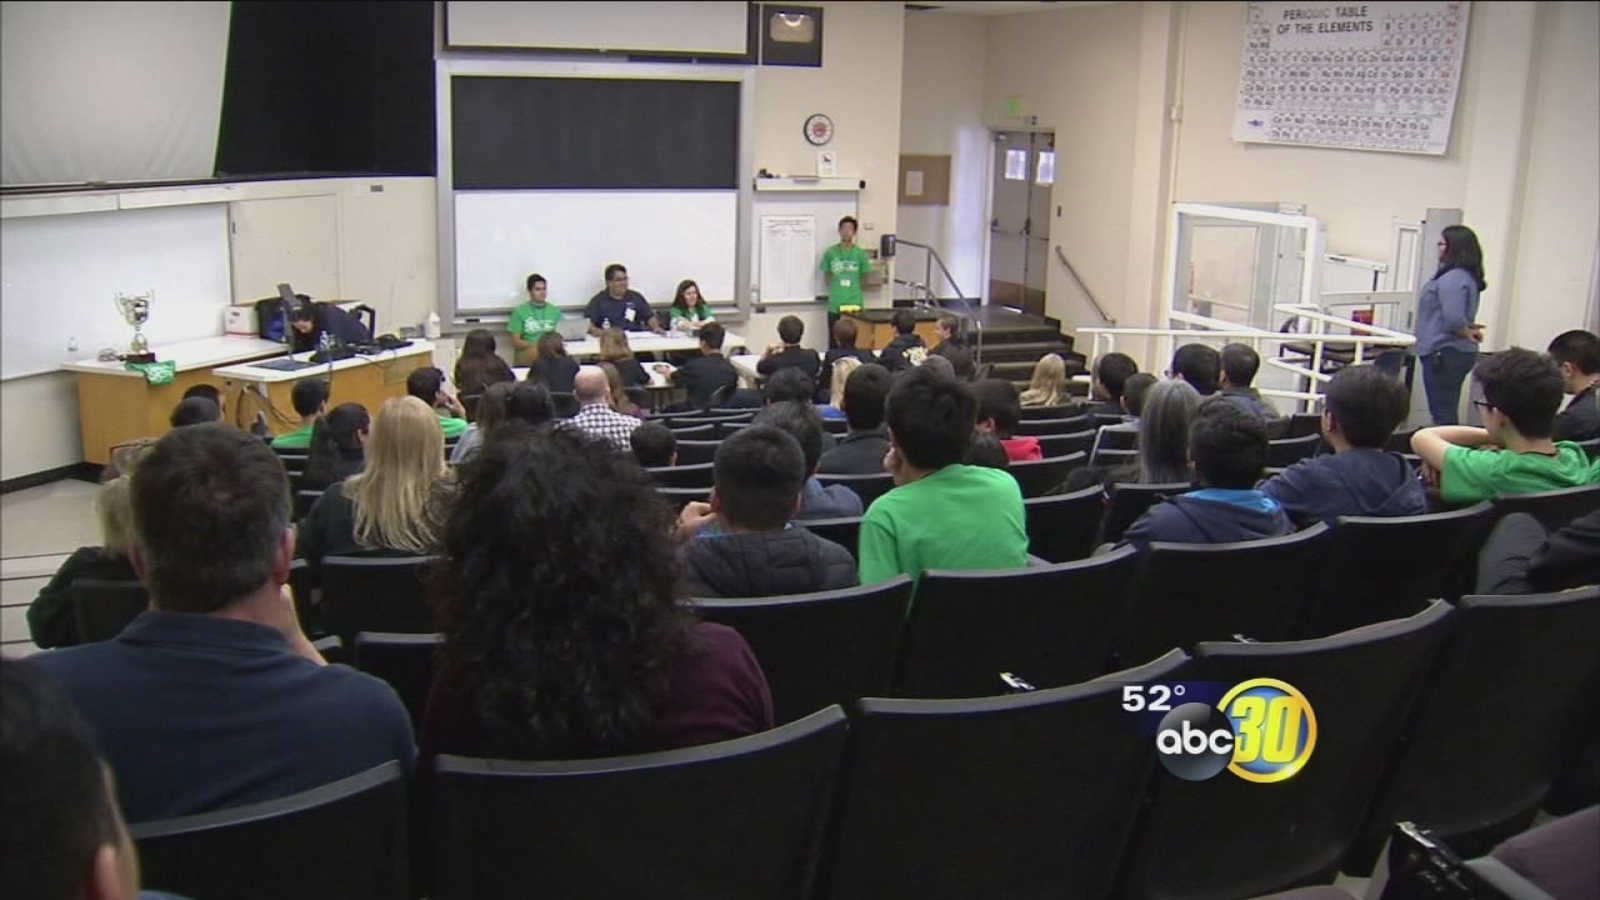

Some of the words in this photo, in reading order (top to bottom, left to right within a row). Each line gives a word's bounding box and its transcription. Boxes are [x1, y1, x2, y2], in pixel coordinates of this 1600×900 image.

[1283, 8, 1330, 20] PERIODIC
[1335, 5, 1369, 17] TABLE
[1277, 23, 1291, 35] OF
[1295, 23, 1314, 34] THE
[1318, 20, 1374, 33] ELEMENTS
